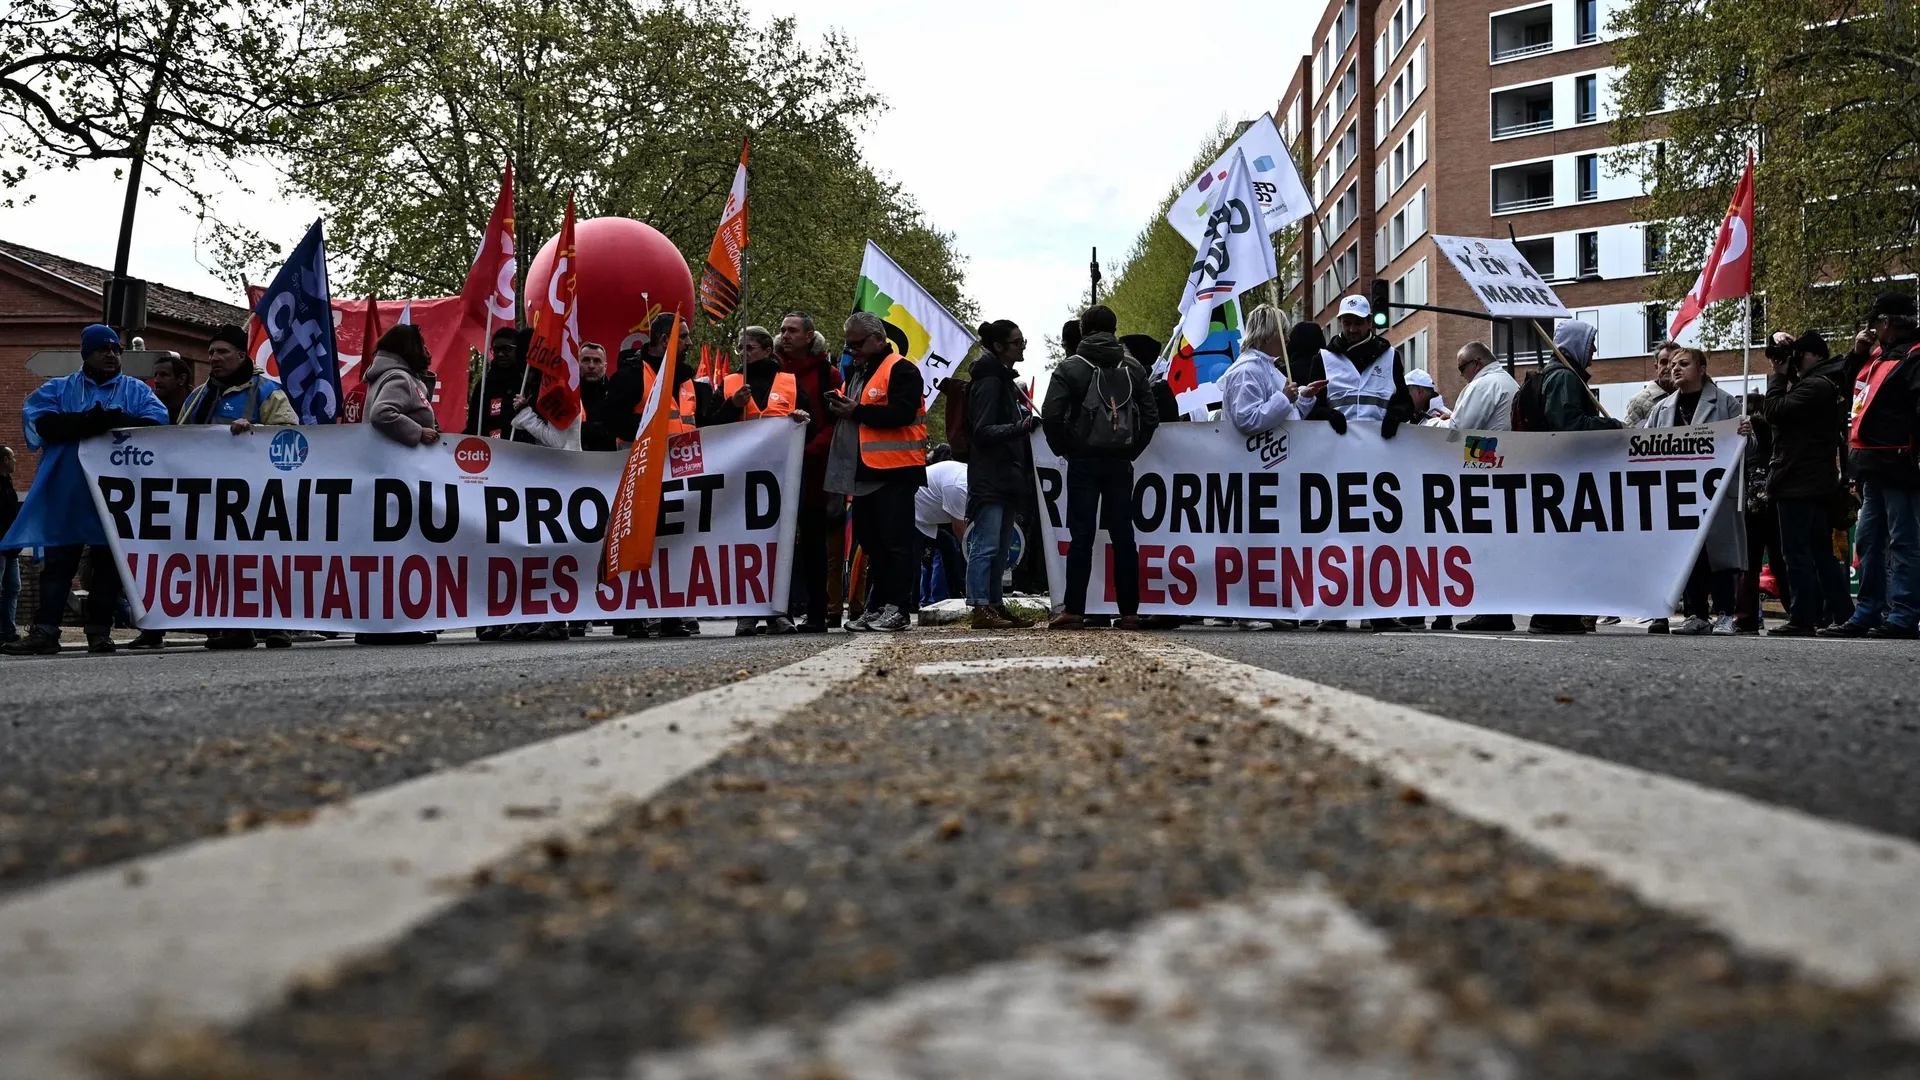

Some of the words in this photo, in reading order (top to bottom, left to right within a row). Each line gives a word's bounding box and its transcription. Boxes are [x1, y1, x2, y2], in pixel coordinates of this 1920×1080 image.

[731, 217, 742, 242] TRA
[1518, 262, 1538, 280] A
[1478, 285, 1558, 307] MARRE
[345, 402, 360, 423] cgt
[670, 441, 701, 462] cgt
[1246, 430, 1273, 453] CFE
[1260, 436, 1287, 462] CGC
[1628, 433, 1715, 457] Solidaires
[110, 446, 154, 466] cftc
[98, 475, 353, 542] RETRAIT
[373, 478, 460, 544] DU
[484, 474, 724, 545] PROET
[1036, 466, 1279, 534] RORME
[1299, 471, 1403, 534] DES
[127, 552, 473, 620] UGMENTATION
[487, 554, 578, 615] DES
[595, 542, 778, 613] SALAIR
[1104, 544, 1198, 606] ES
[1215, 545, 1475, 608] PENSIONS
